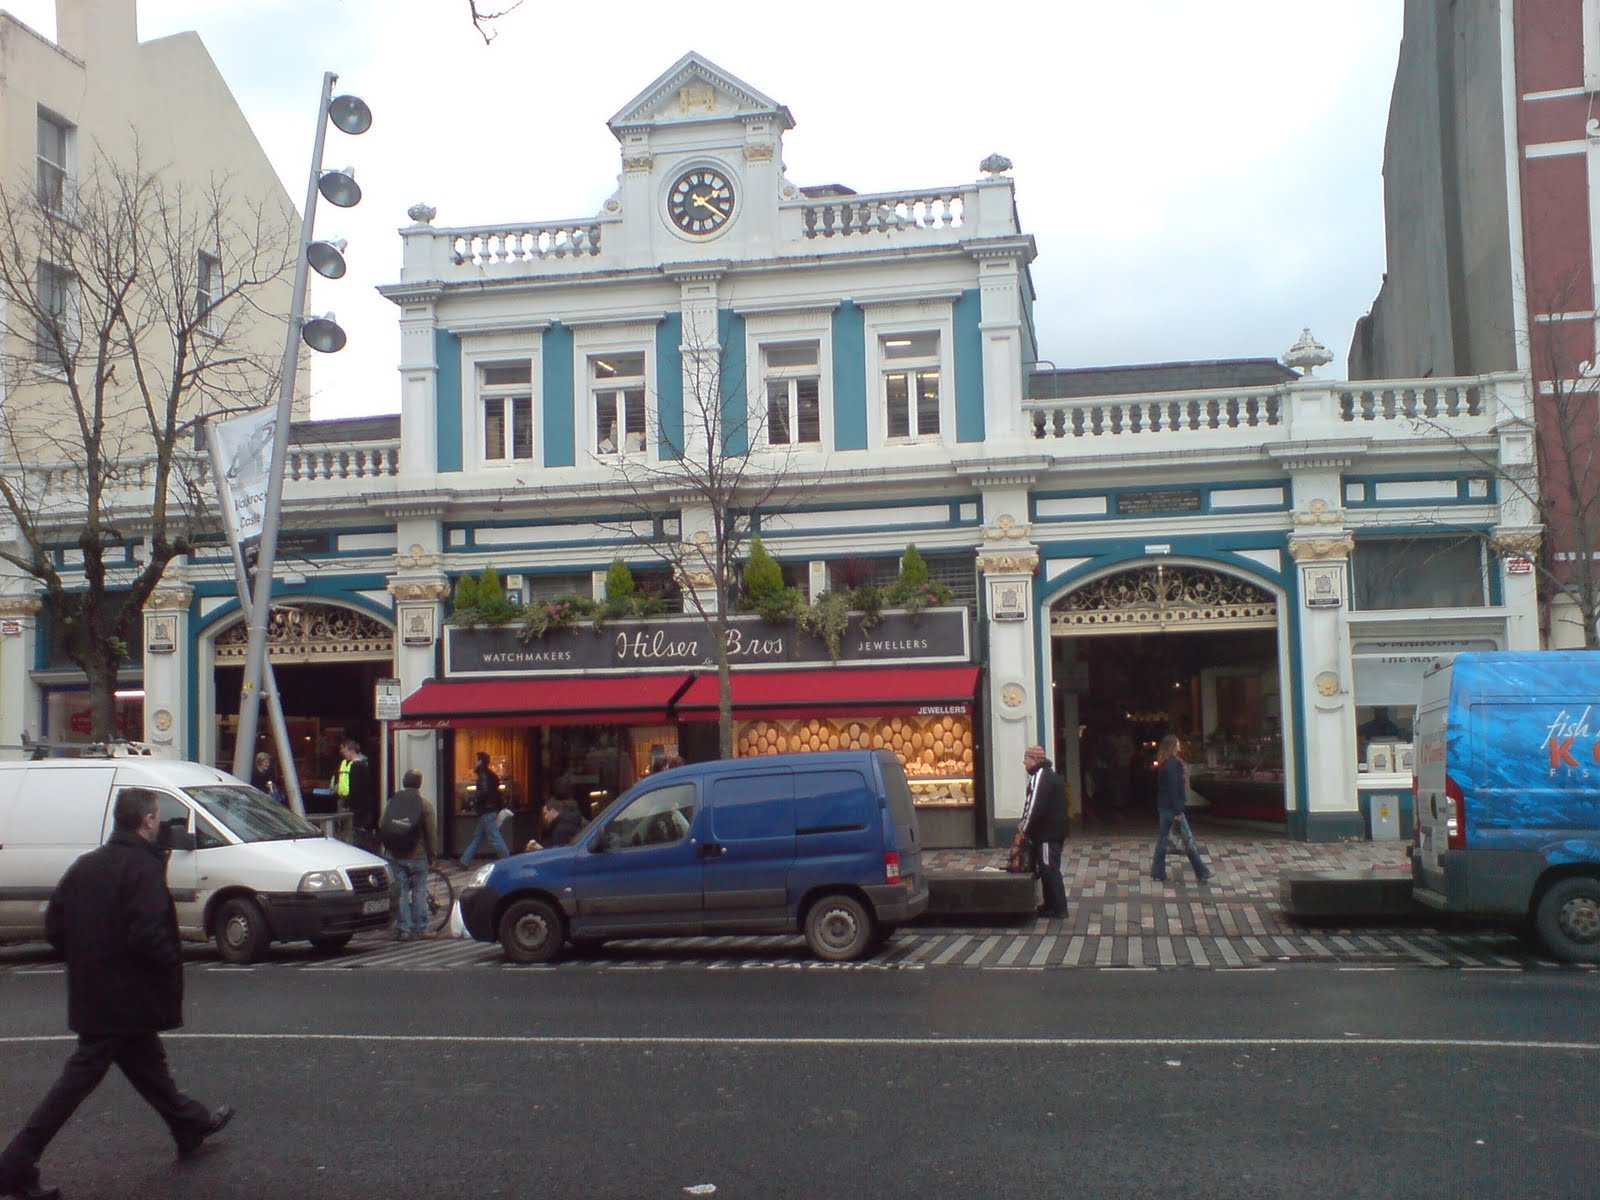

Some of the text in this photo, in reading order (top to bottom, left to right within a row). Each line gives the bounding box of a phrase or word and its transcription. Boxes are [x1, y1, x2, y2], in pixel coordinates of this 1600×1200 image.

[616, 628, 783, 658] Hilser Bros
[858, 639, 928, 651] JEWELLERS
[483, 651, 571, 662] WATCHMAKERS
[386, 686, 392, 696] L
[917, 706, 966, 714] JEWELLERS
[1541, 705, 1592, 749] fish
